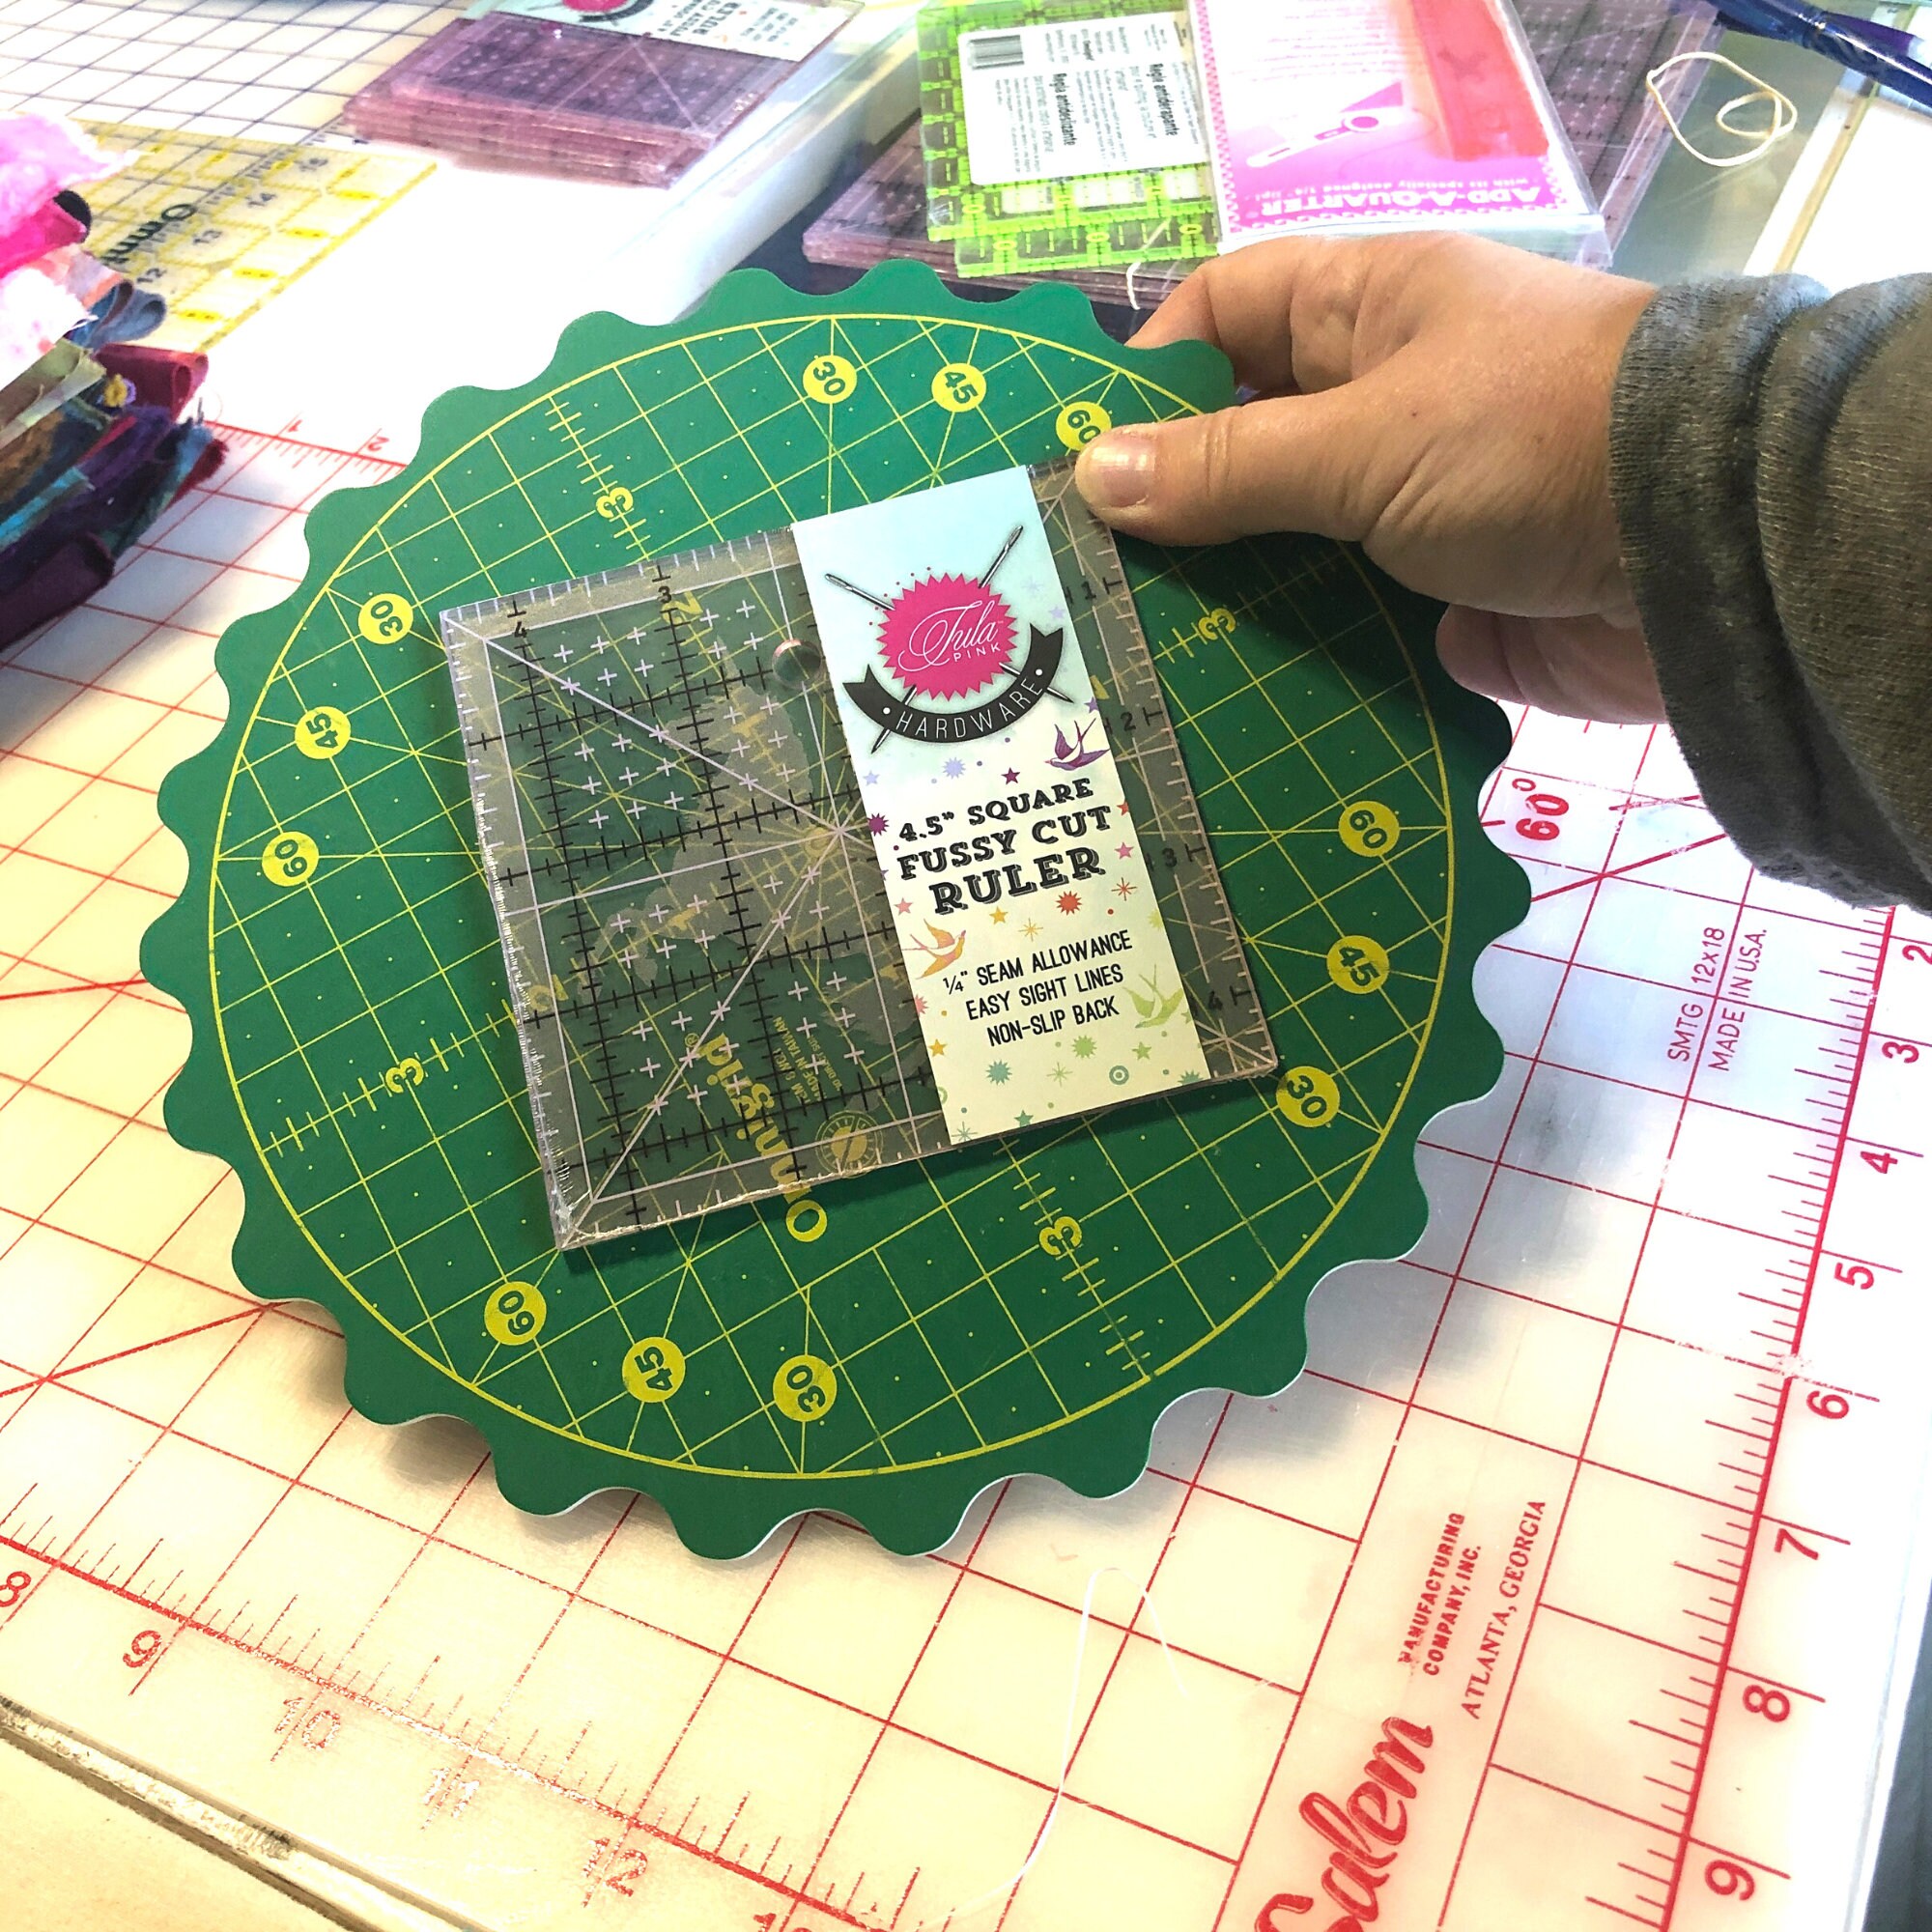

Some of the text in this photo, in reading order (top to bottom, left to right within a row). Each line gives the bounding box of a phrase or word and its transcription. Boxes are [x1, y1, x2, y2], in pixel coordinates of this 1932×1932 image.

[1261, 185, 1542, 216] ADD-A-QUARTER
[811, 359, 848, 398] 30
[942, 370, 978, 405] 45
[1066, 410, 1100, 443] 60
[596, 486, 634, 520] 3
[657, 585, 671, 604] 3
[1080, 581, 1097, 601] 1
[370, 599, 404, 638] 30
[513, 621, 527, 638] 4
[897, 600, 1000, 672] Tula
[1198, 607, 1236, 640] 3
[952, 641, 1002, 663] PINK
[895, 677, 1043, 739] HARDWARE
[1120, 711, 1137, 732] 2
[305, 712, 340, 750] 45
[967, 777, 1094, 826] SQUARE
[895, 805, 1112, 881] FUSSY CUT
[1349, 809, 1388, 849] 60
[274, 838, 309, 878] 60
[1161, 847, 1178, 867] 3
[928, 845, 1107, 916] RULER
[976, 956, 1025, 986] SEAM
[1031, 929, 1134, 974] ALLOWANCE
[1337, 946, 1381, 987] 45
[965, 963, 1125, 1021] EASY SIGHT LINES
[1208, 990, 1224, 1011] 4
[1666, 926, 1726, 1063] SMTG 12x18
[1708, 928, 1768, 1072] MADE IN U.S.A.
[986, 995, 1121, 1047] NON-SLIP BACK
[1881, 1040, 1920, 1065] 3
[385, 1057, 425, 1094] 3
[1286, 1073, 1327, 1120] 30
[1860, 1150, 1899, 1175] 4
[1038, 1215, 1083, 1256] 3
[1833, 1260, 1876, 1292] 5
[497, 1289, 535, 1337] 60
[633, 1345, 675, 1392] 45
[784, 1364, 827, 1414] 30
[1804, 1387, 1851, 1421] 6
[1774, 1526, 1821, 1561] 7
[0, 1570, 32, 1608] 8
[1422, 1545, 1482, 1677] COMPANY, INC.
[1461, 1500, 1547, 1720] ATLANTA, GEORGIA
[122, 1629, 163, 1669] 9
[1742, 1685, 1791, 1724] 8
[1704, 1859, 1756, 1902] 9
